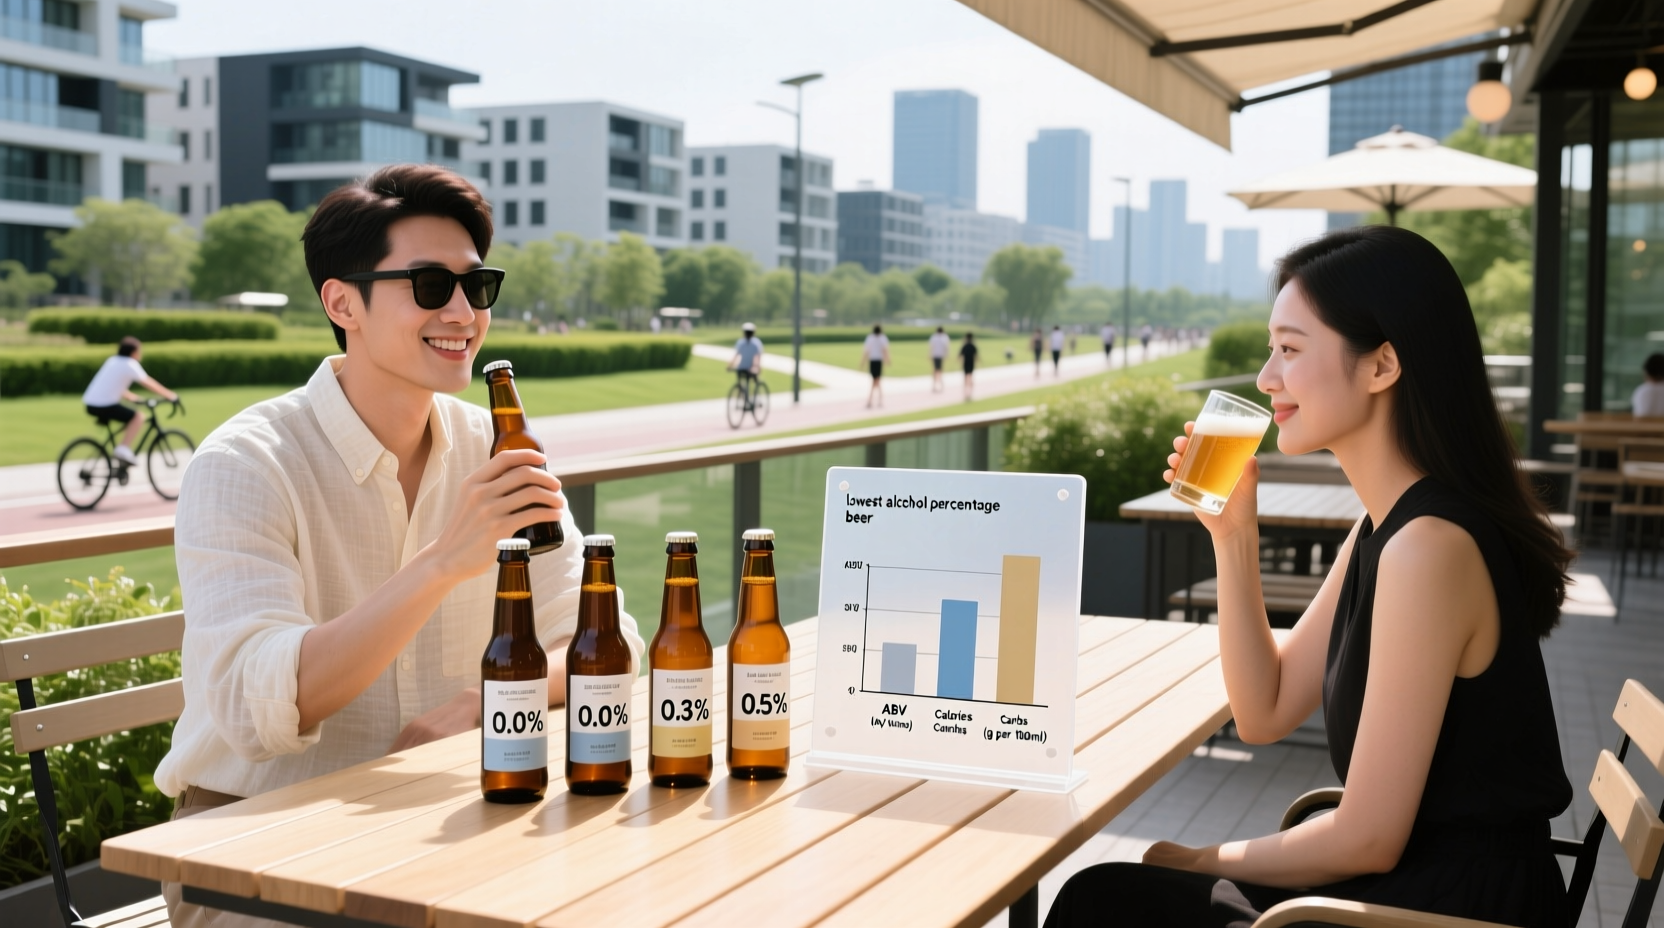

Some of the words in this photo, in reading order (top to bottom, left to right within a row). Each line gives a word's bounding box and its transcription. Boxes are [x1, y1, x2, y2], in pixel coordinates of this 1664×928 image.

[846, 493, 882, 508] lowest
[929, 499, 1001, 514] percentage
[845, 509, 873, 524] beer
[578, 703, 628, 727] 0.0%
[661, 698, 709, 721] 0.3%
[741, 692, 788, 715] 0.5%
[881, 703, 908, 716] ABV
[492, 710, 544, 734] 0.0%
